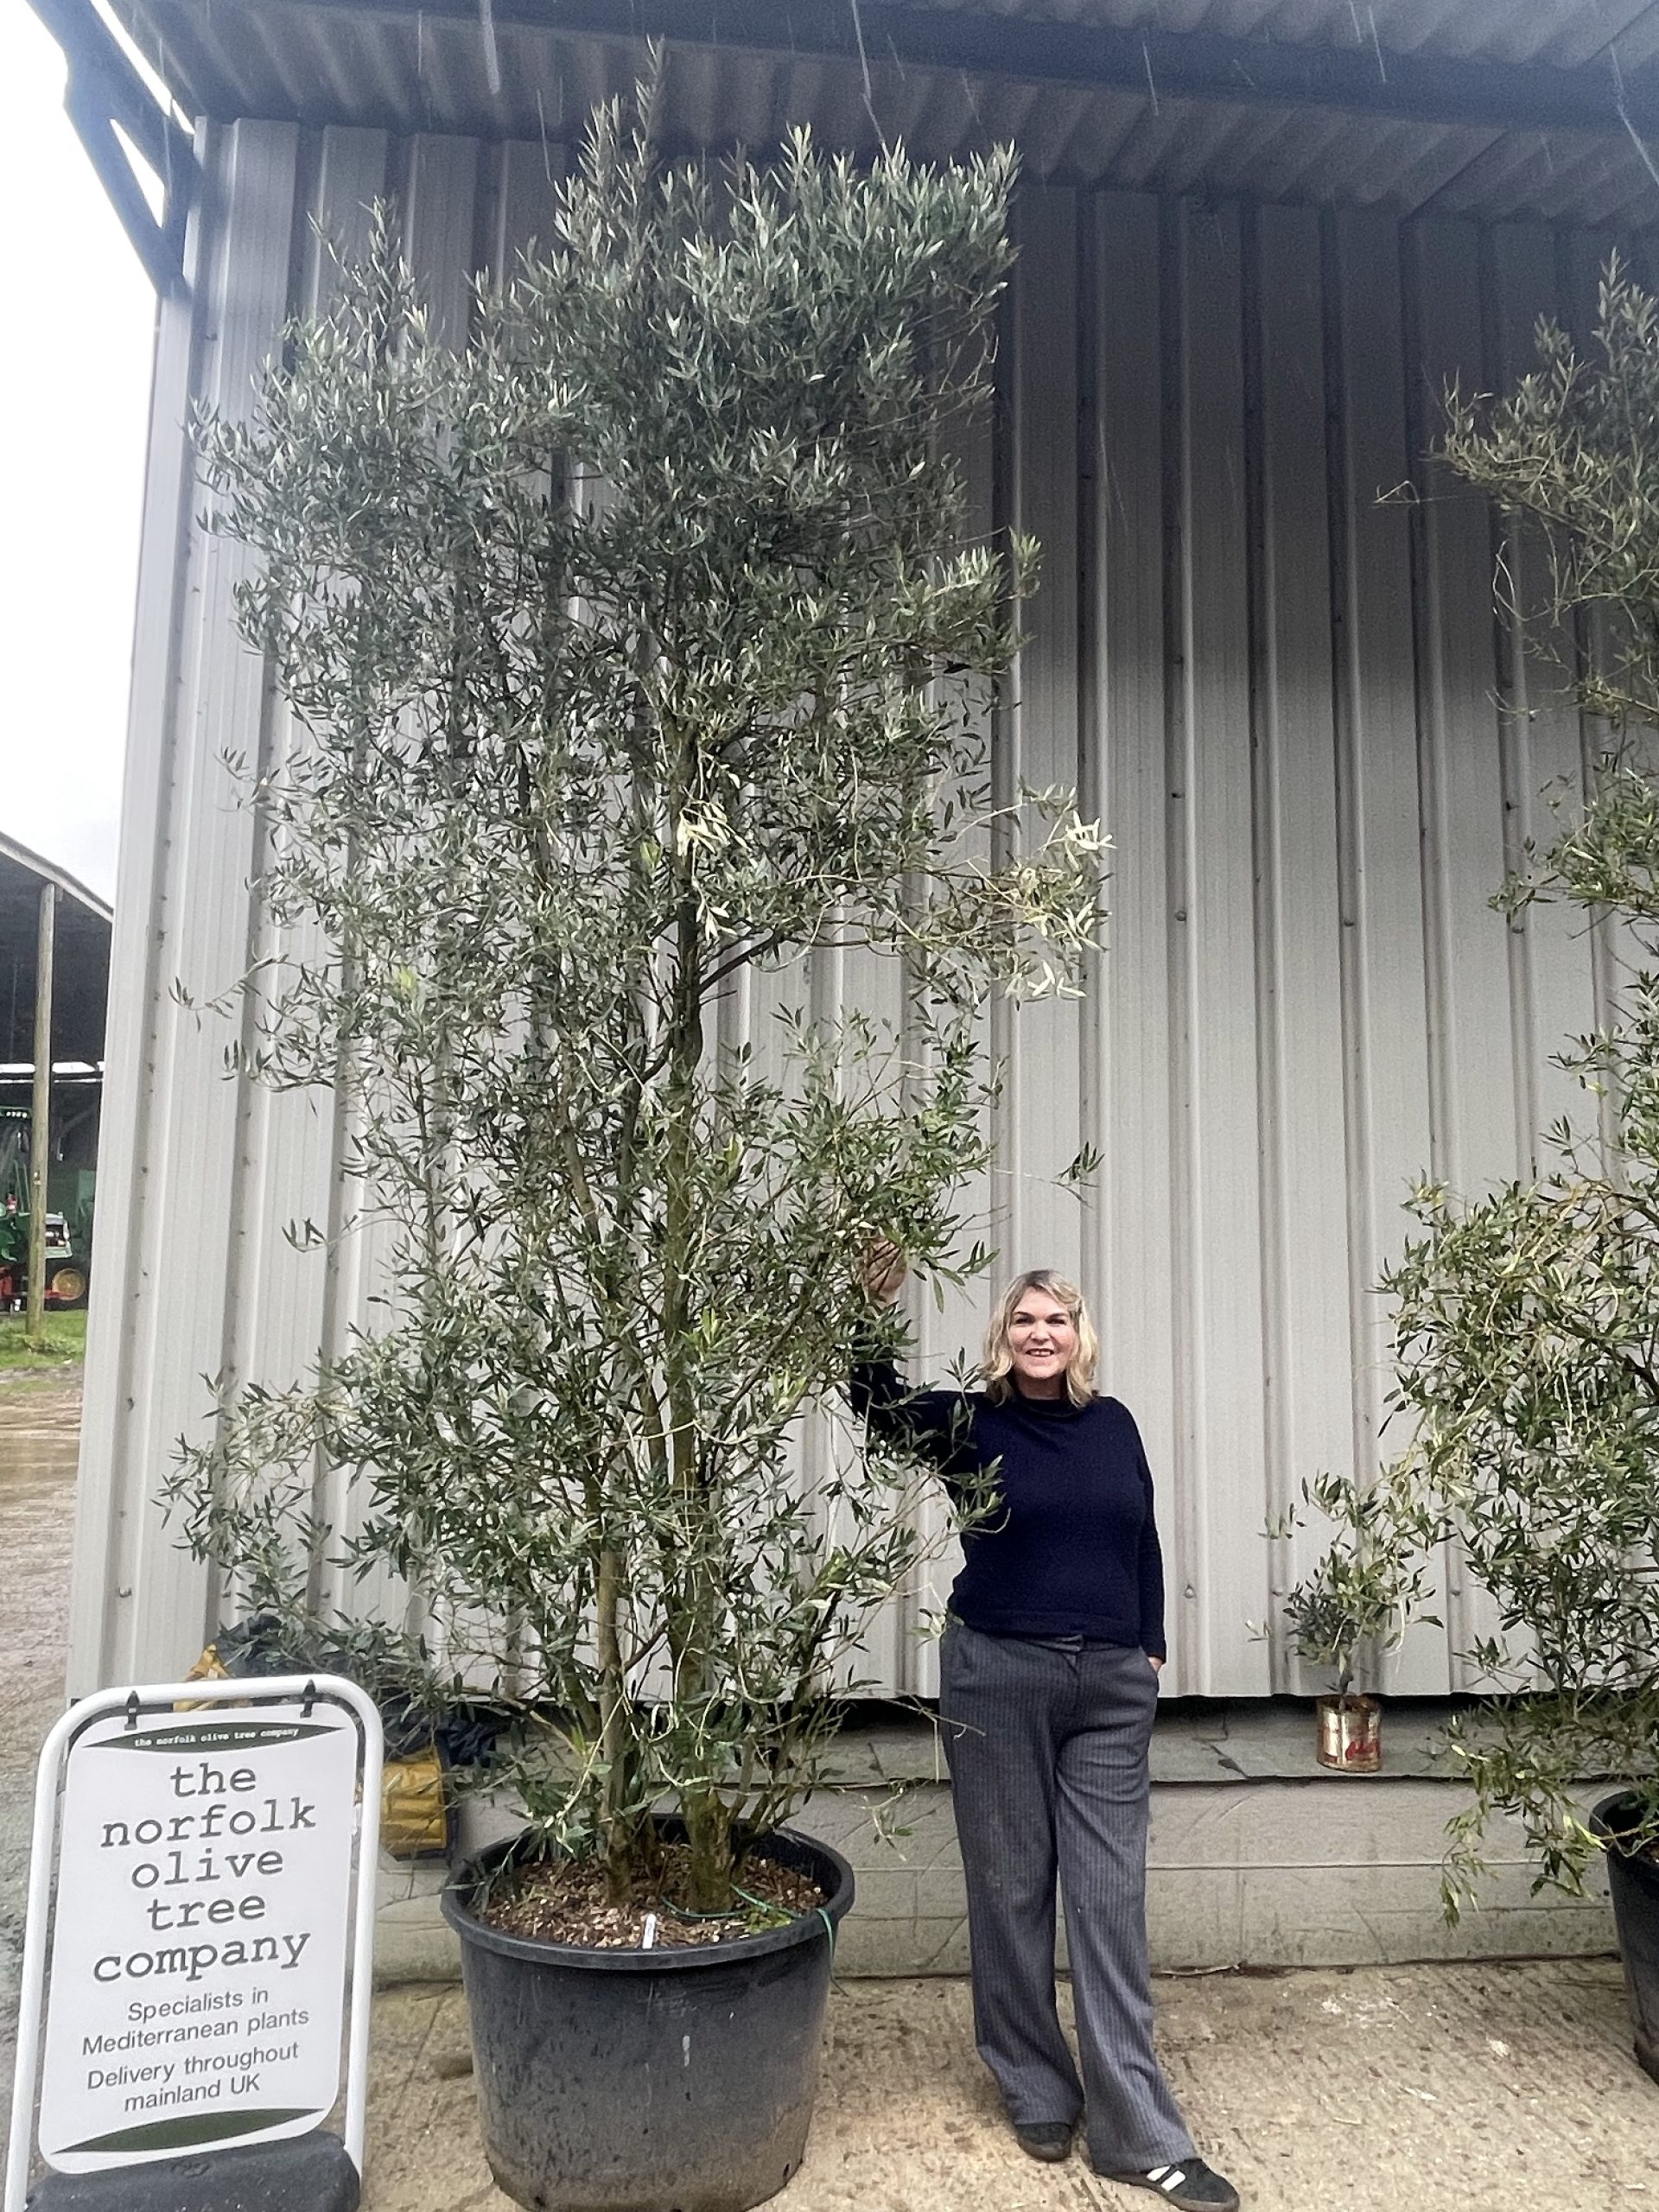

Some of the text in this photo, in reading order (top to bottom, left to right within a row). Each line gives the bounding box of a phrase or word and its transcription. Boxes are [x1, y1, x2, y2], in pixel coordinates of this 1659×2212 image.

[134, 1727, 299, 1747] the norfolk olive tree company
[170, 1764, 256, 1797] the
[100, 1797, 315, 1847] norfolk
[131, 1848, 283, 1889] olive
[147, 1895, 265, 1930] tree
[93, 1932, 310, 1982] company
[127, 1987, 268, 2023] Specialists in
[82, 2009, 309, 2056] Mediterranean plants
[86, 2042, 299, 2091] Delivery throughout
[124, 2074, 260, 2112] mainland UK
